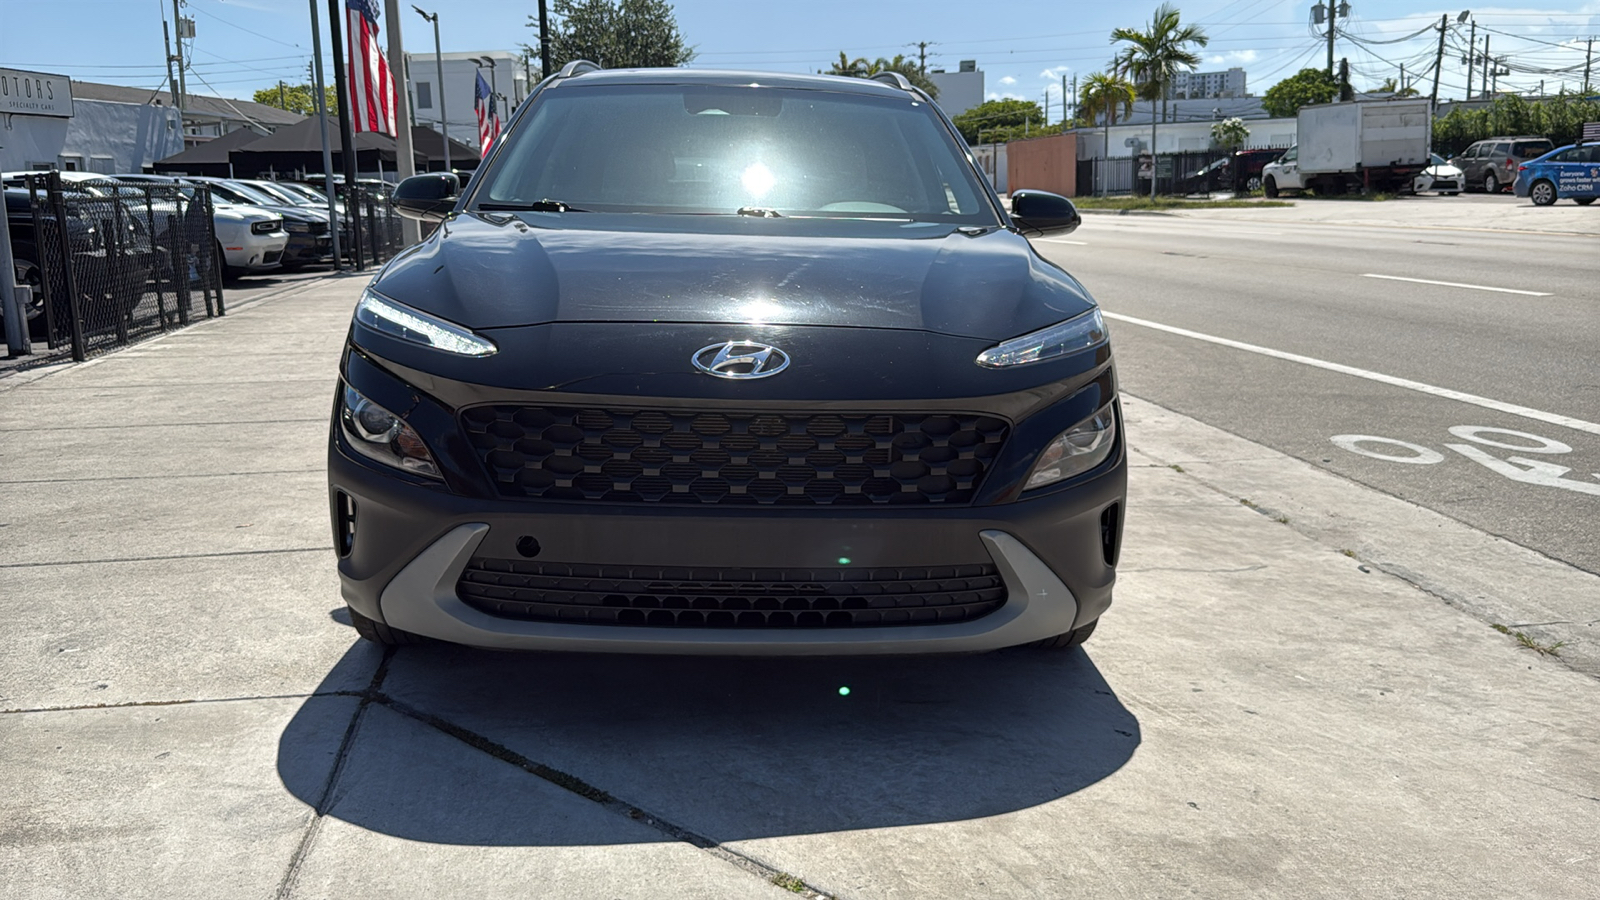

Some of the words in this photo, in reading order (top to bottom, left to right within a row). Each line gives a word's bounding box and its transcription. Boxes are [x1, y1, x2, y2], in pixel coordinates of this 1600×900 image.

[1, 75, 54, 100] OTORS
[9, 101, 39, 109] SPECIALTY
[40, 103, 55, 111] CARS
[1577, 183, 1593, 191] CRM
